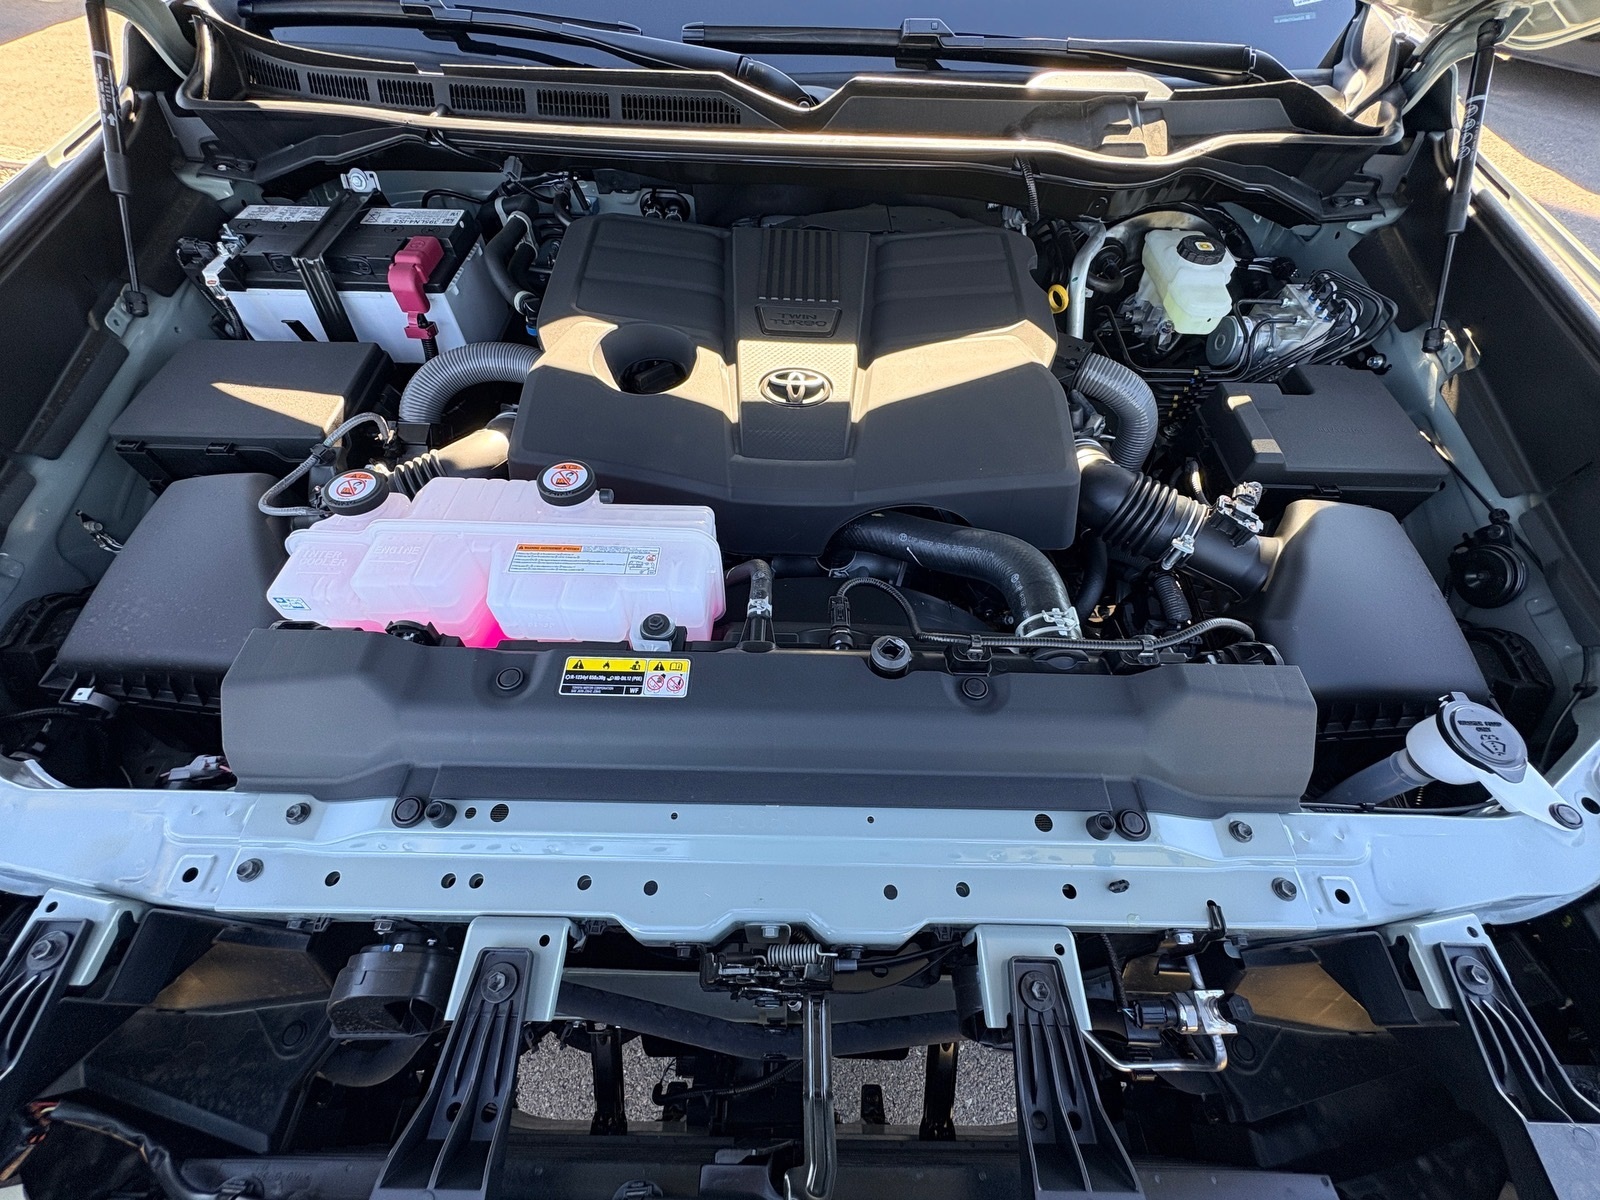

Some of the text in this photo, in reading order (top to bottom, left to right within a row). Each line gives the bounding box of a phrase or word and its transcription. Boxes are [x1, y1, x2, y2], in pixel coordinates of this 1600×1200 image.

[770, 319, 827, 327] TURBO
[302, 550, 343, 559] INTER
[374, 545, 421, 555] ENGINE
[299, 558, 348, 567] COOLER
